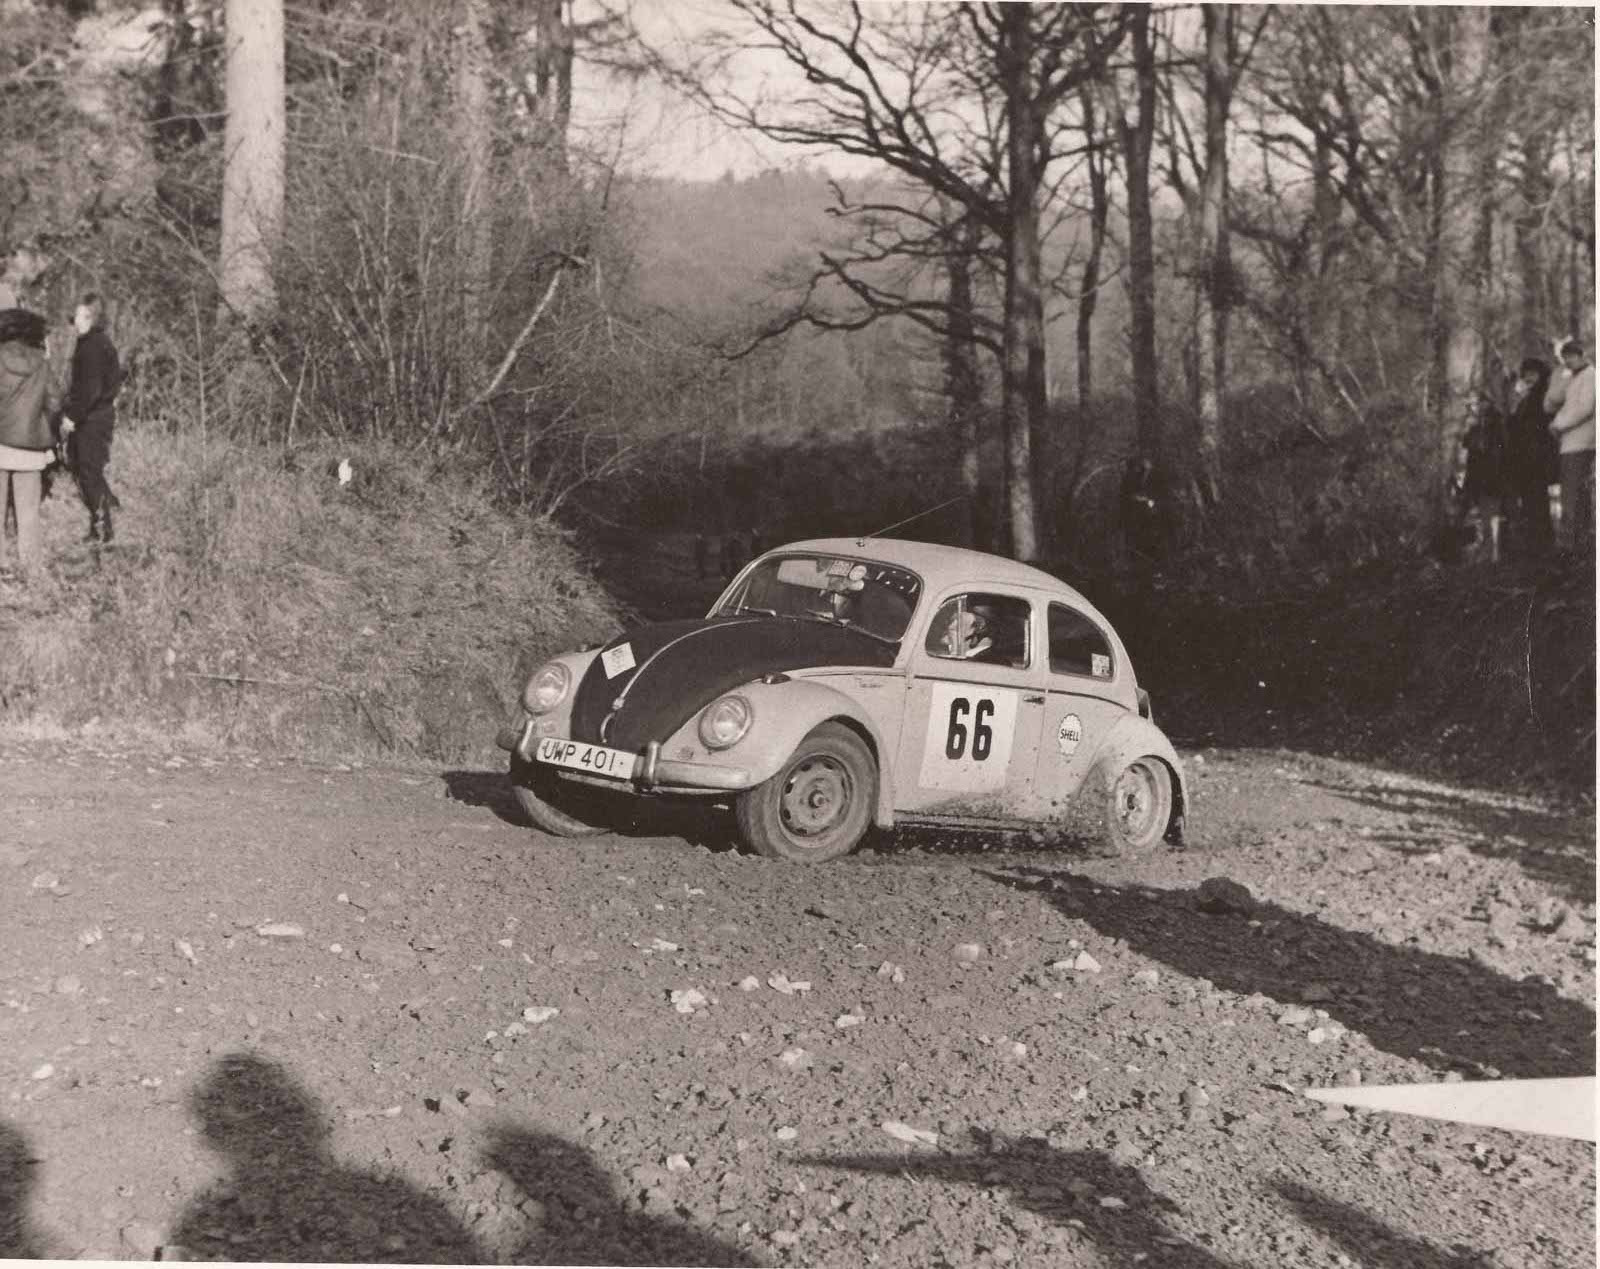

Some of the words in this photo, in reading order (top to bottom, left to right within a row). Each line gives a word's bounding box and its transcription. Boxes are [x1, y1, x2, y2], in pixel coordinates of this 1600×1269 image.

[945, 697, 995, 761] 66
[1060, 728, 1079, 742] SHELL
[543, 741, 576, 763] UWP
[581, 748, 616, 772] 401
